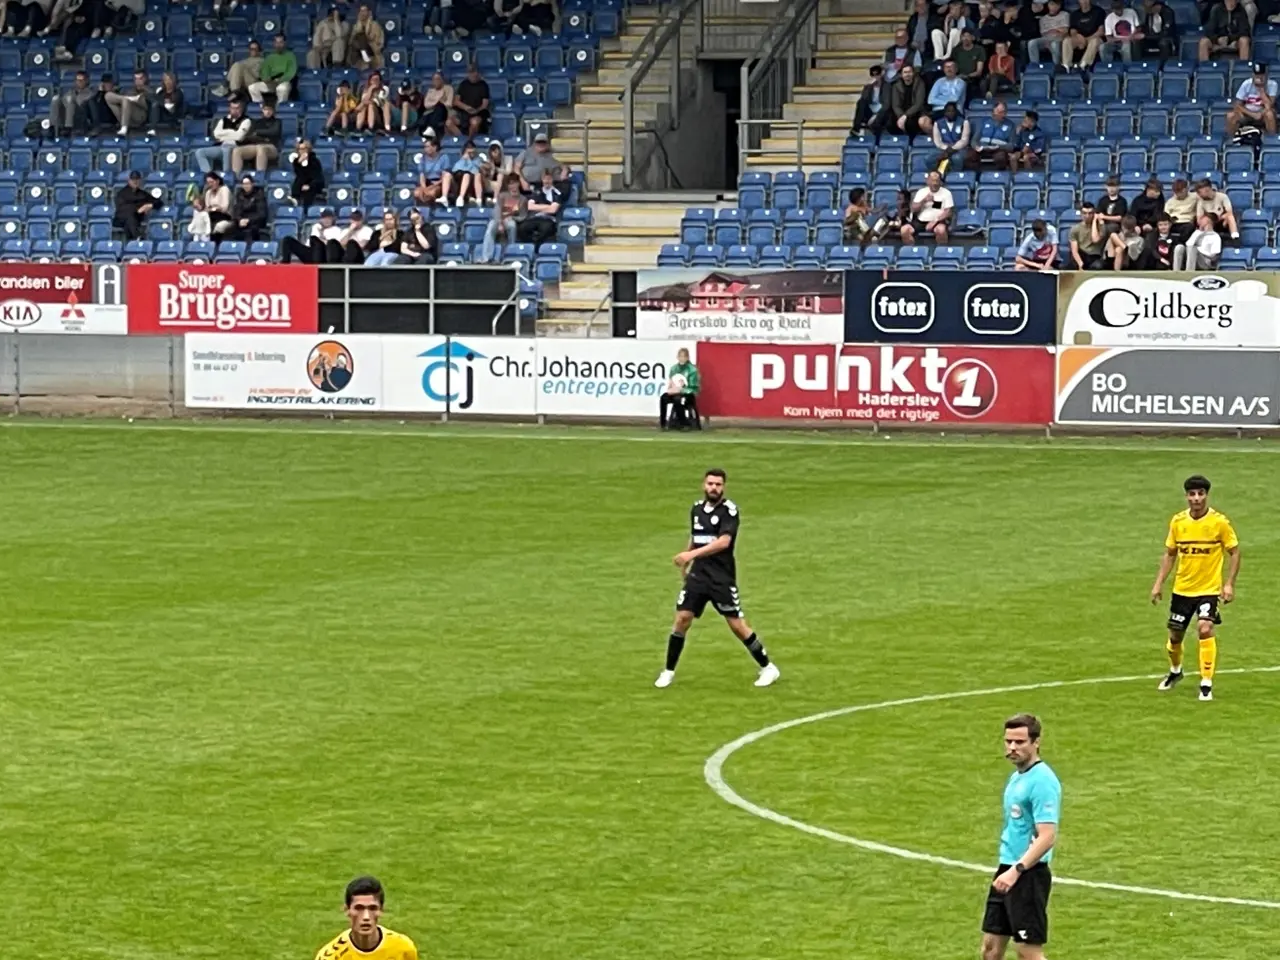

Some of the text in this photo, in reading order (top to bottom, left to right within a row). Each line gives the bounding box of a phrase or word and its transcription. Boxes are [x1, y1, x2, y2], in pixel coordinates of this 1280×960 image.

[55, 276, 85, 290] biler
[178, 270, 225, 292] Super
[3, 306, 34, 320] KIA
[159, 284, 291, 330] Brugsen
[1088, 288, 1233, 328] Gildberg
[760, 318, 774, 330] og
[489, 356, 532, 378] Chr.
[537, 356, 666, 379] Johannsen
[751, 346, 981, 407] punkt 1
[542, 380, 665, 399] entreprenør
[1092, 373, 1127, 392] BO
[859, 393, 939, 407] Haderslev
[1092, 394, 1270, 416] MICHELSEN A/S
[783, 406, 940, 421] Kom hjem med det rigtige
